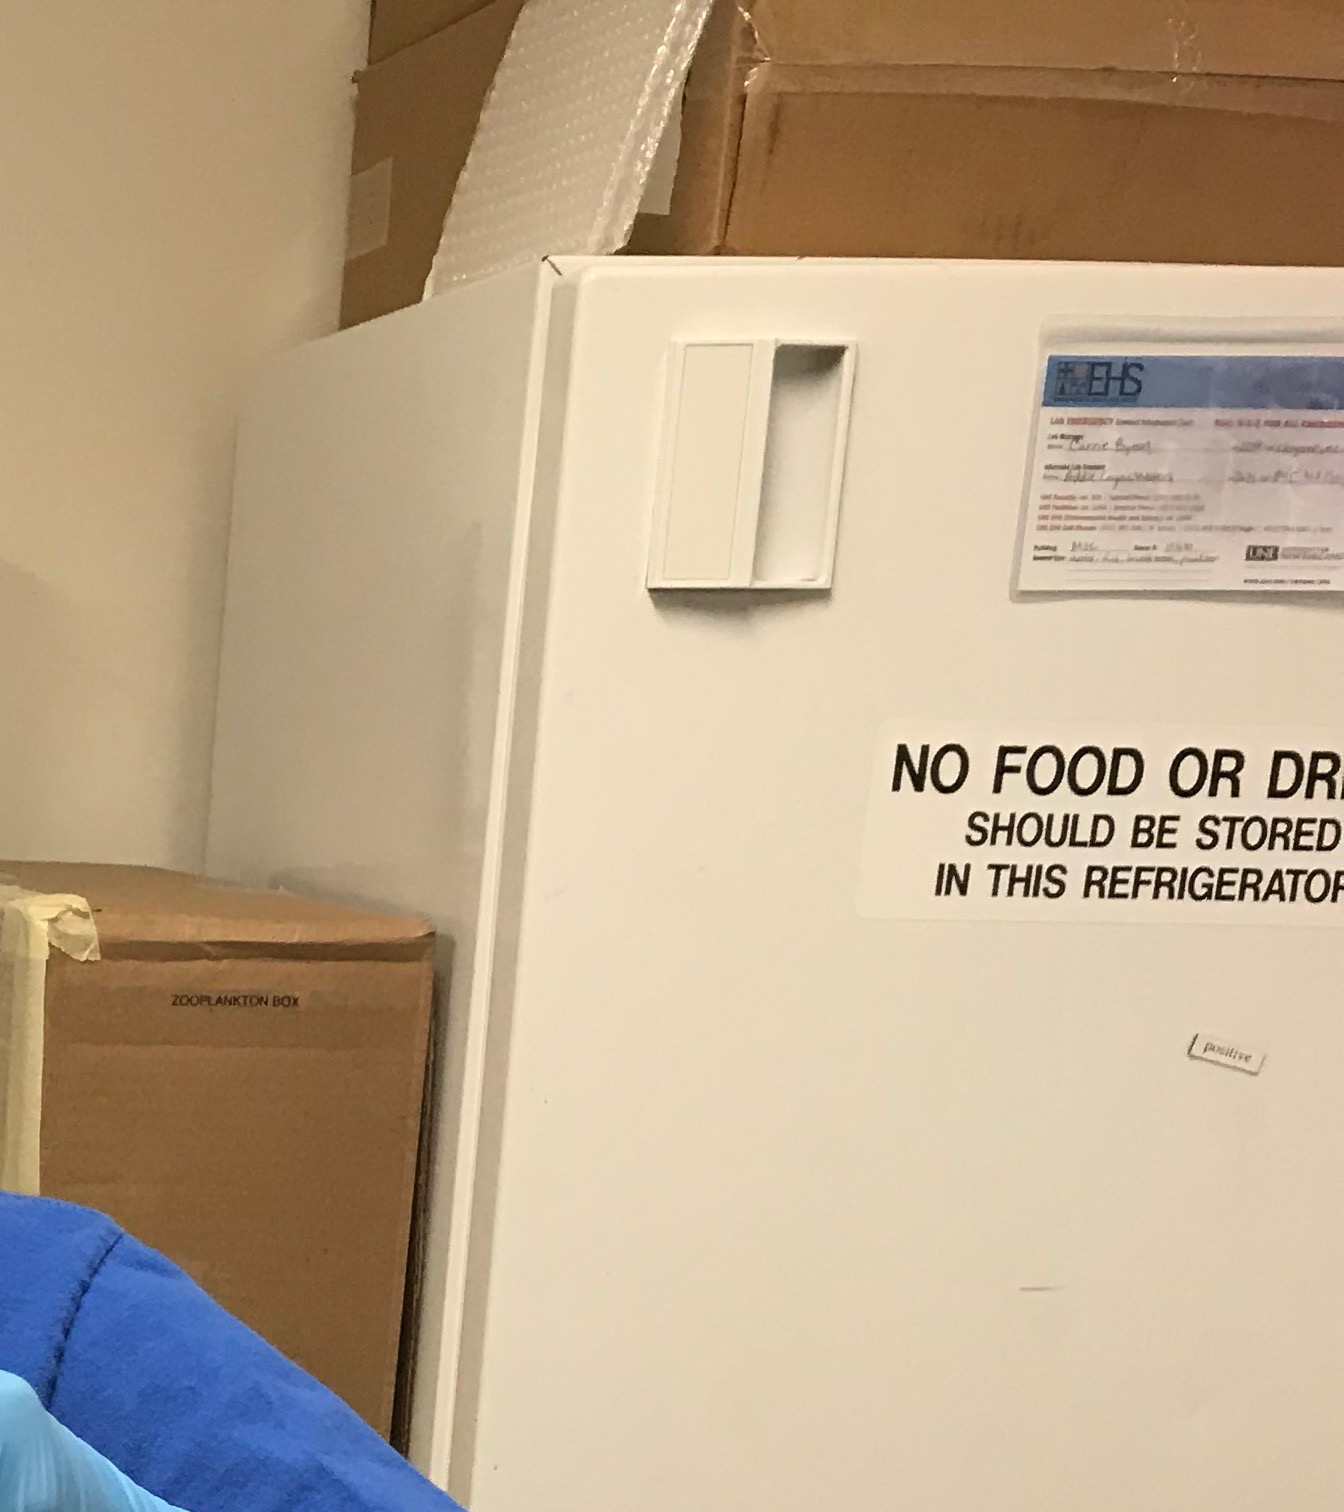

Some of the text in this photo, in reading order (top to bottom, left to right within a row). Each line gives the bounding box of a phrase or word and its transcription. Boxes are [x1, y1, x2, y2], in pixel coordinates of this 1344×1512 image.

[1088, 361, 1144, 396] EHS
[891, 743, 1344, 801] NO FOOD OR DR
[965, 811, 1342, 852] SHOULD BE STORED
[934, 863, 971, 897] IN
[987, 863, 1067, 899] THIS
[171, 994, 300, 1008] ZOOPLANKTON BOX
